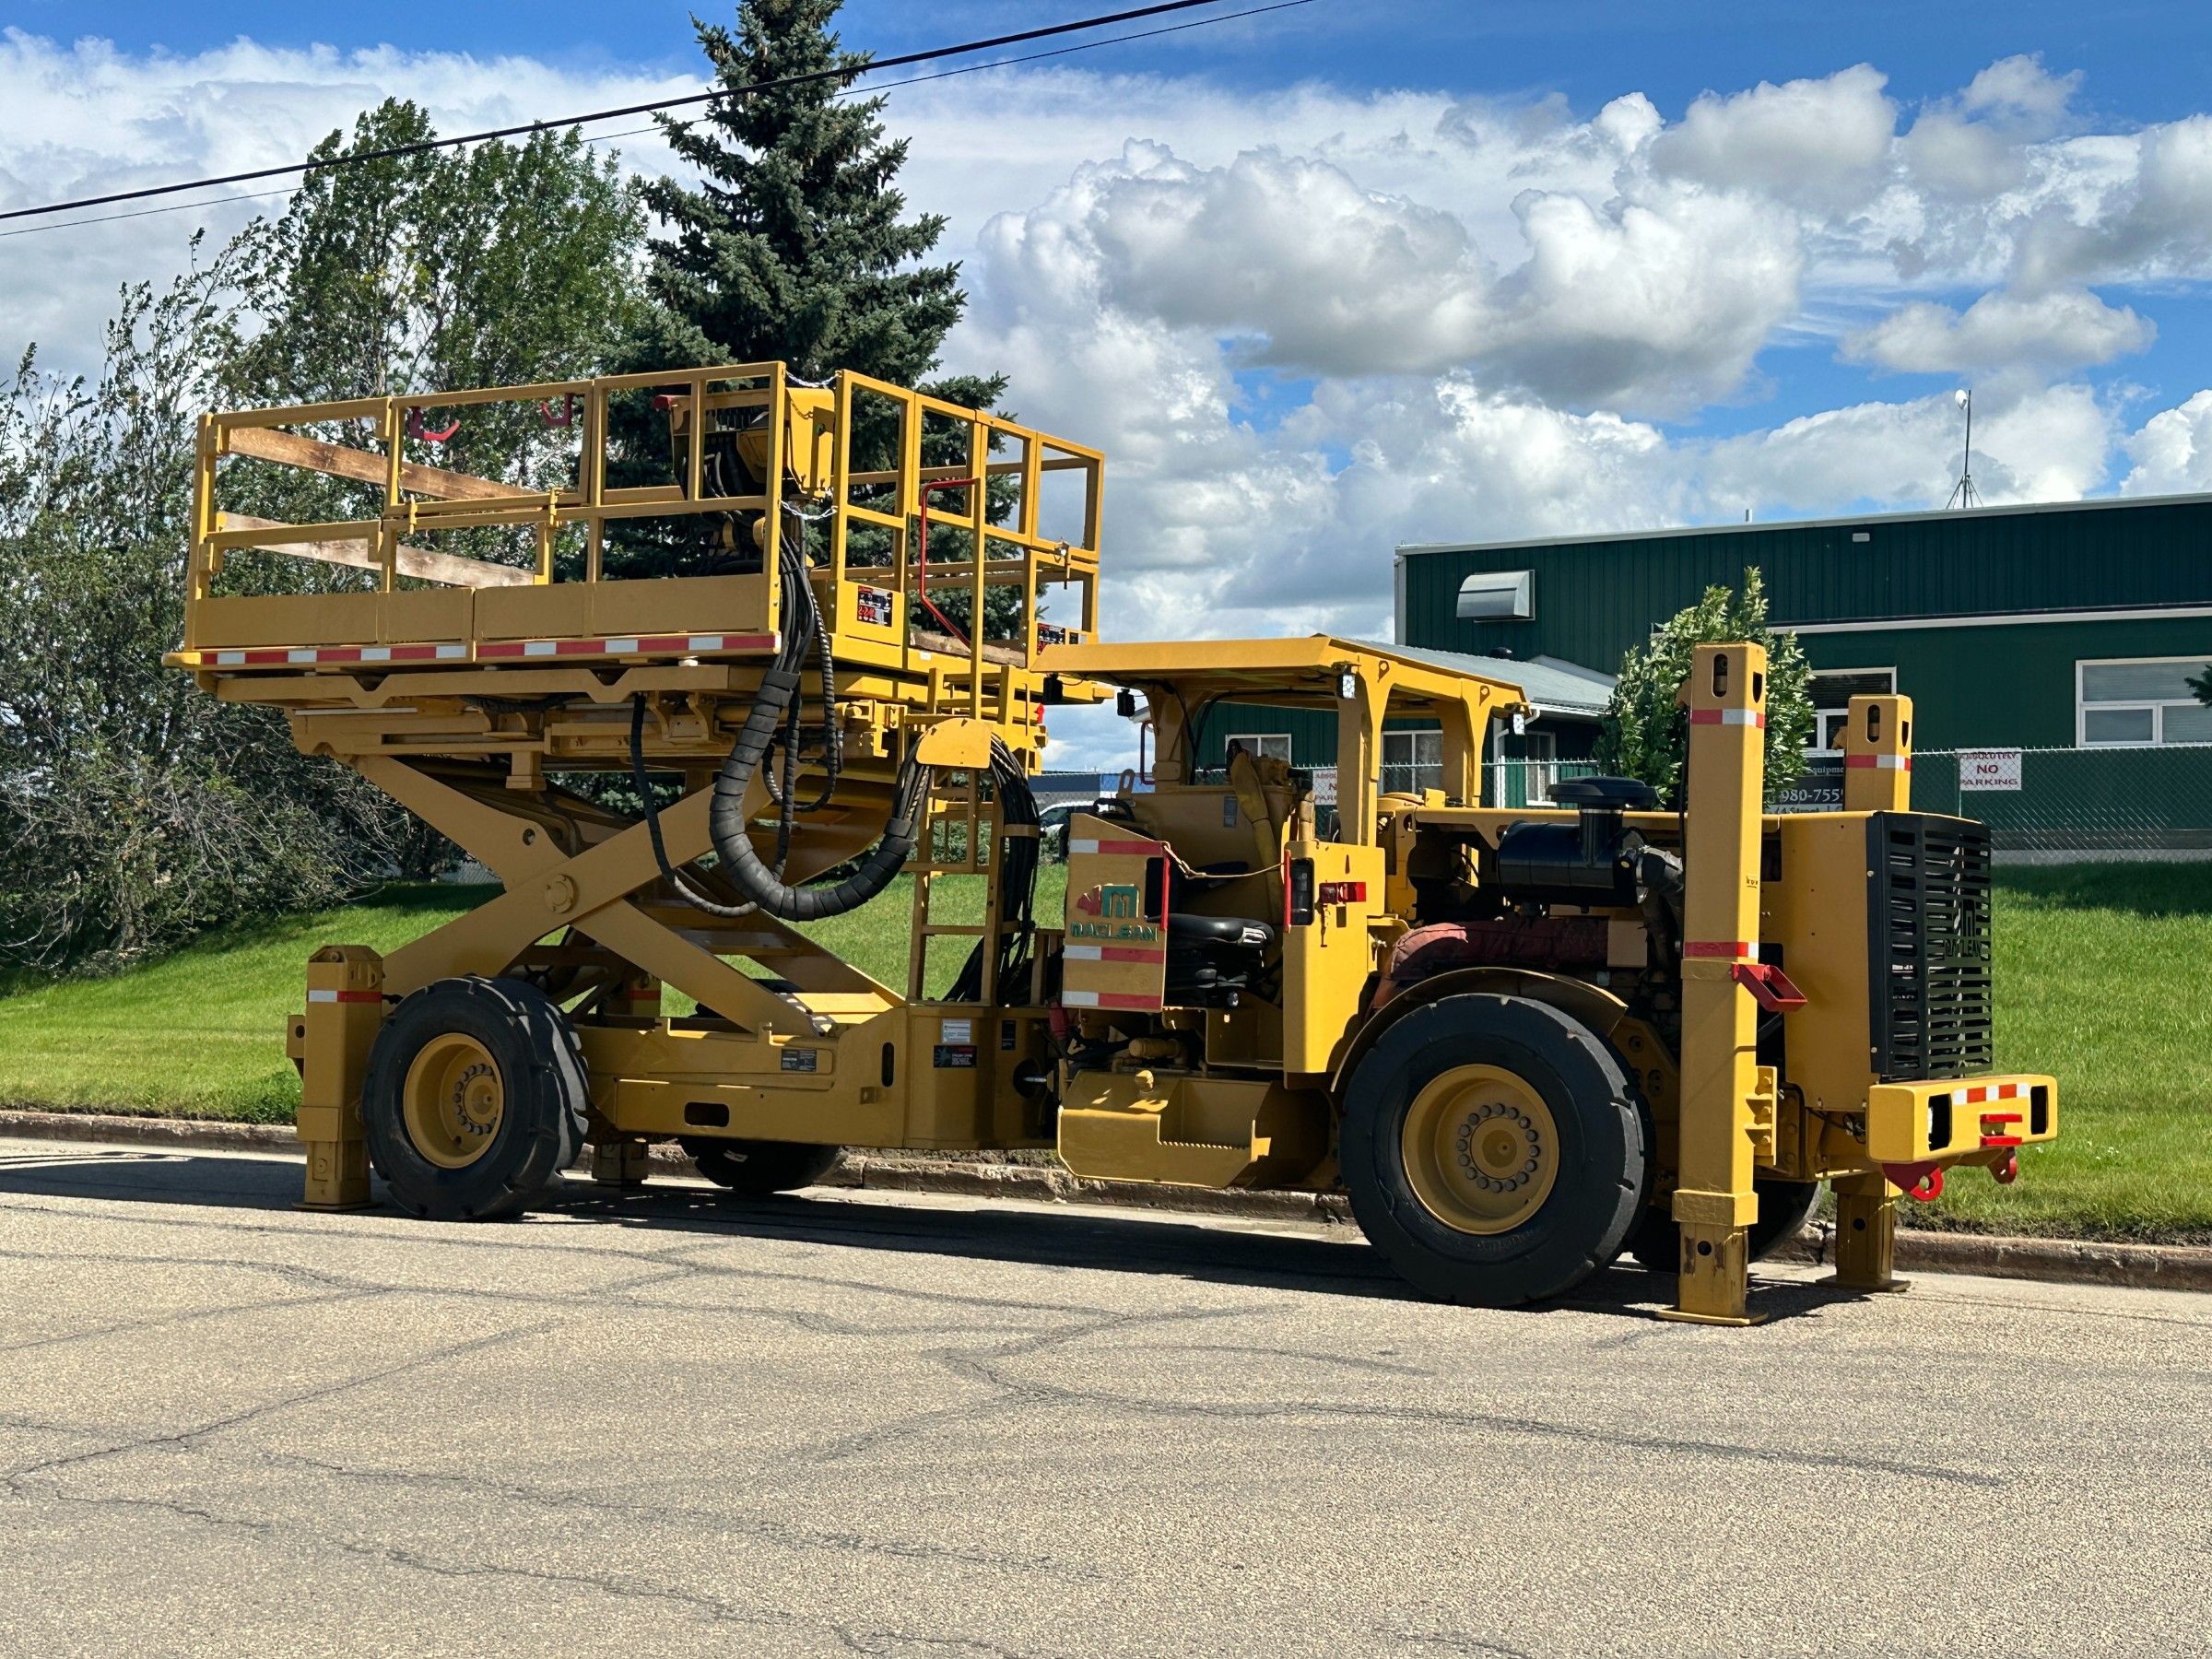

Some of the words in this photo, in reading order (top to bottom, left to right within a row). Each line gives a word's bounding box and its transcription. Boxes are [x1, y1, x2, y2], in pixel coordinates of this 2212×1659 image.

[1976, 764, 1999, 774] NO
[1960, 778, 2019, 786] PARKING
[1780, 788, 1844, 803] 980-755
